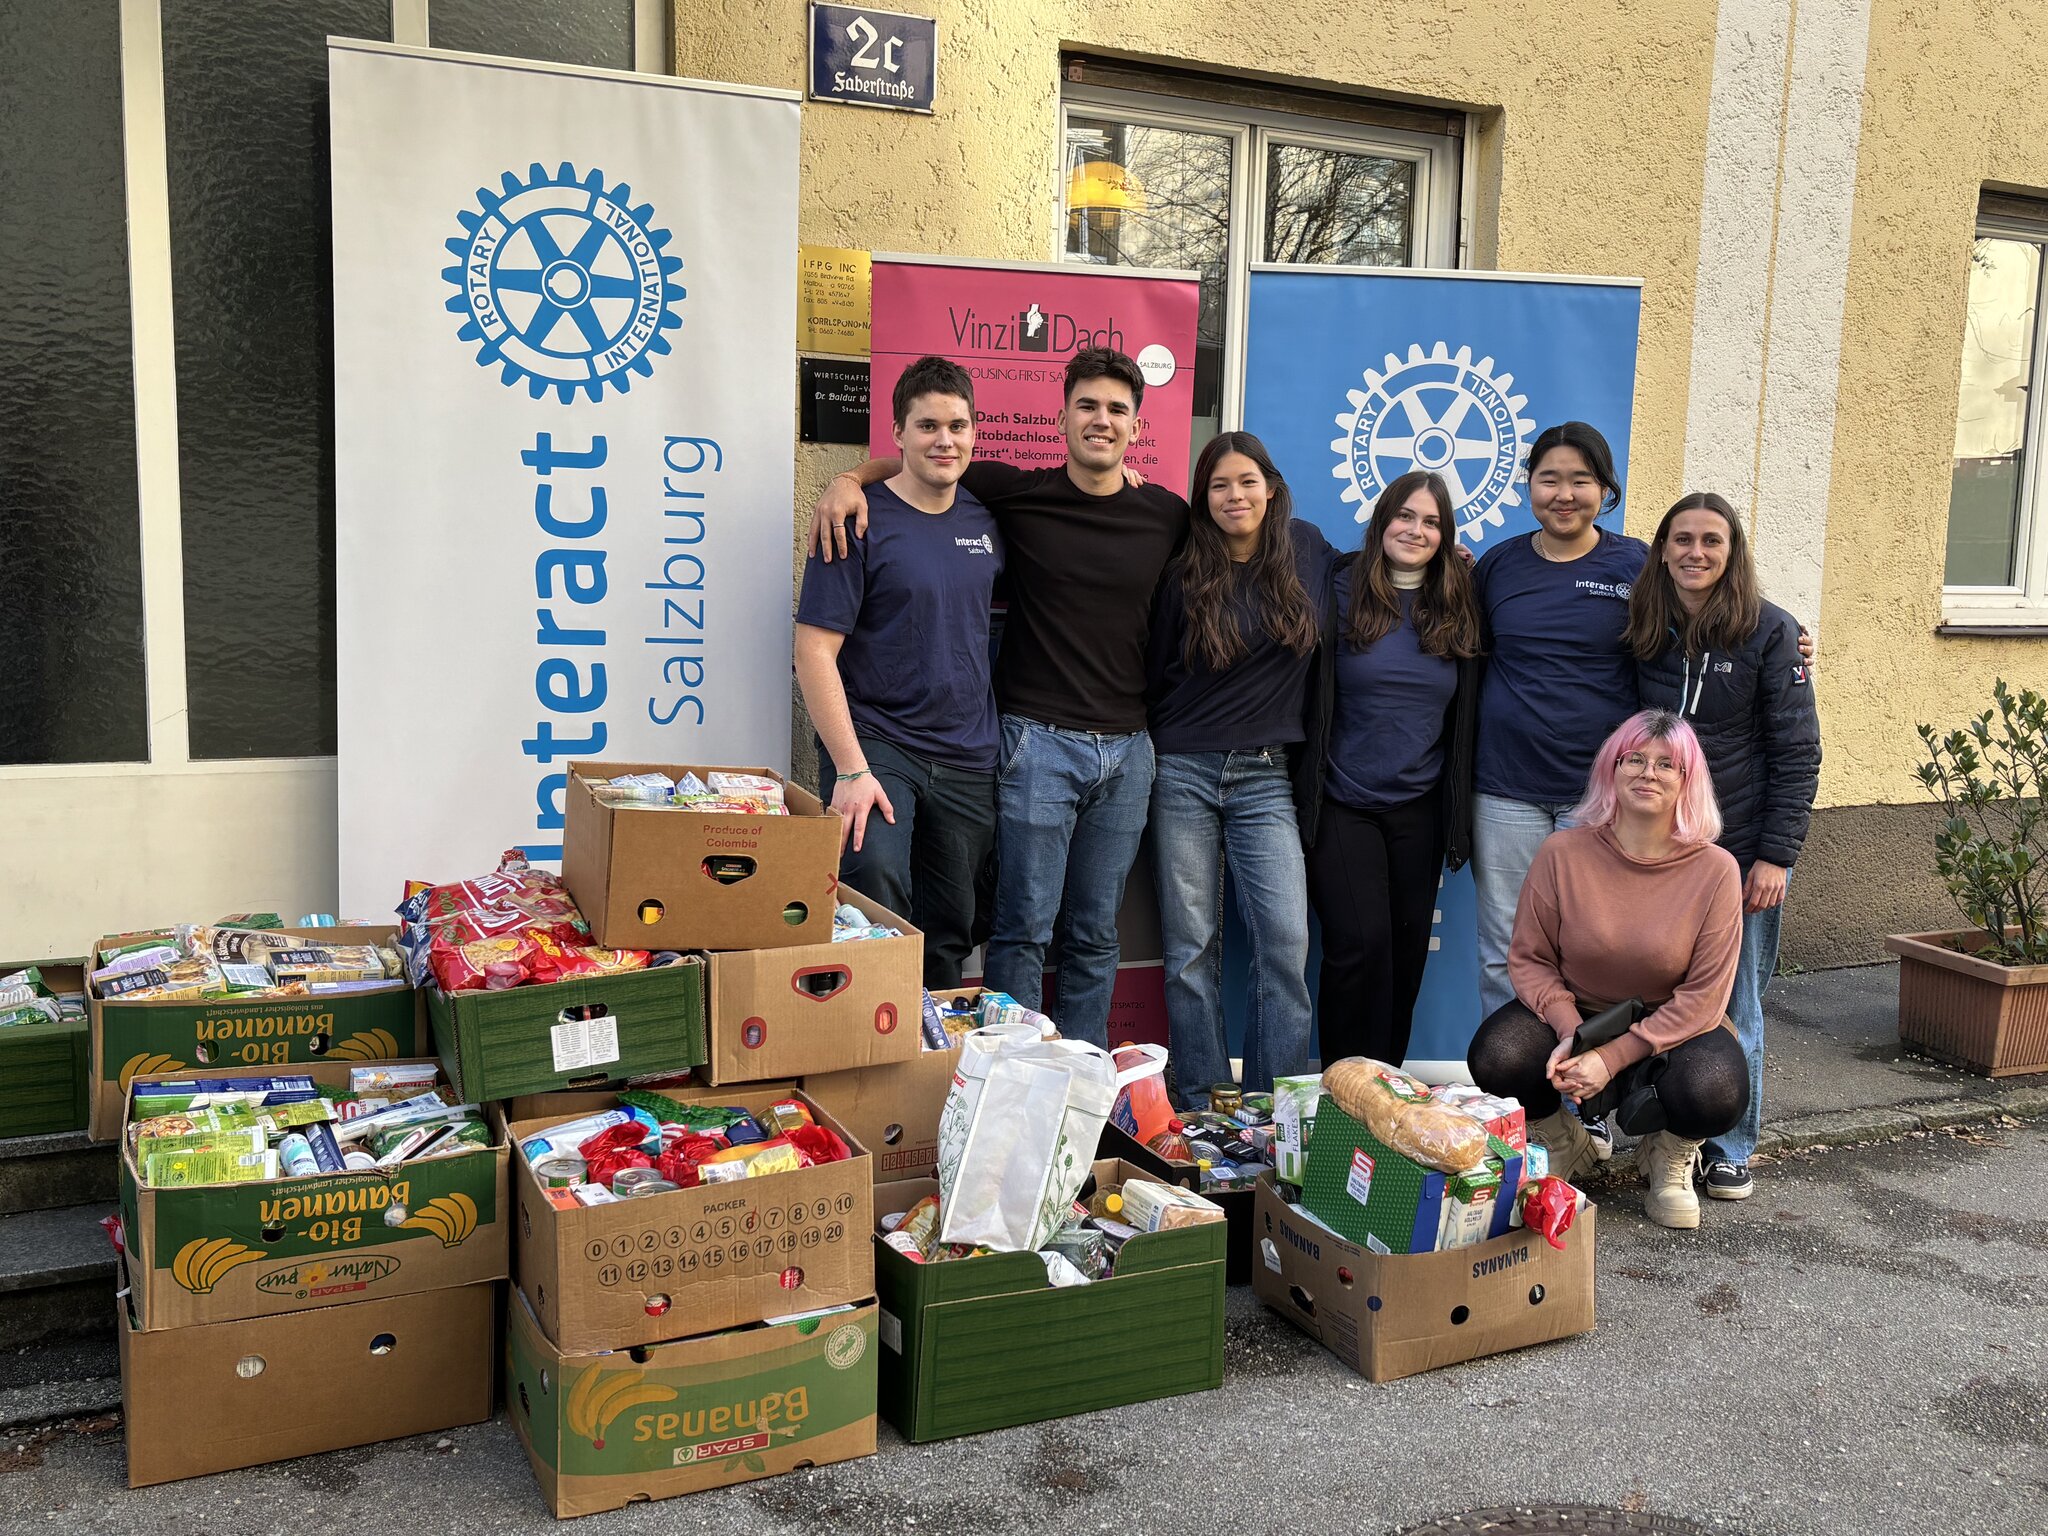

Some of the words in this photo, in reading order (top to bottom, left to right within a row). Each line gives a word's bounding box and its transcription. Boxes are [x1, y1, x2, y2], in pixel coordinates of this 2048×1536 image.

[845, 16, 904, 74] 2c
[470, 227, 499, 329] ROTARY
[604, 202, 660, 369] INTERNATIONAL
[949, 306, 1015, 351] Vinzi
[1052, 313, 1124, 353] Dach
[1018, 369, 1047, 383] FIRST
[1139, 360, 1173, 371] SALZBURG
[1012, 412, 1056, 426] Salzbu
[975, 429, 1063, 444] itobdachlose.
[1354, 402, 1378, 490] ROTARY
[1462, 374, 1514, 522] INTERNATIONAL
[1142, 453, 1159, 465] die
[645, 435, 723, 725] Salzburg
[1575, 579, 1614, 592] Interact
[703, 824, 748, 835] Produce
[751, 825, 763, 836] of
[706, 838, 758, 849] Colombia
[195, 1013, 335, 1041] Bananen
[231, 1041, 290, 1065] Bio-
[271, 1179, 333, 1197] Landwirtschaft
[260, 1181, 410, 1223] Bananen
[703, 1198, 746, 1214] PACKER
[297, 1217, 362, 1246] Bio-
[1279, 1218, 1320, 1261] BANANAS
[601, 1267, 618, 1282] 11
[628, 1263, 646, 1278] 12
[653, 1259, 672, 1274] 13
[679, 1253, 698, 1269] 14
[704, 1249, 722, 1264] 15
[731, 1244, 747, 1259] 16
[755, 1239, 773, 1254] 17
[780, 1234, 796, 1249] 18
[804, 1230, 819, 1244] 19
[826, 1225, 842, 1239] 20
[1472, 1246, 1528, 1279] BANANAS
[261, 1267, 298, 1288] pur
[328, 1258, 391, 1282] Natur
[311, 1284, 355, 1297] SPAR
[633, 1385, 810, 1442] Bananas
[698, 1437, 755, 1457] SPAR
